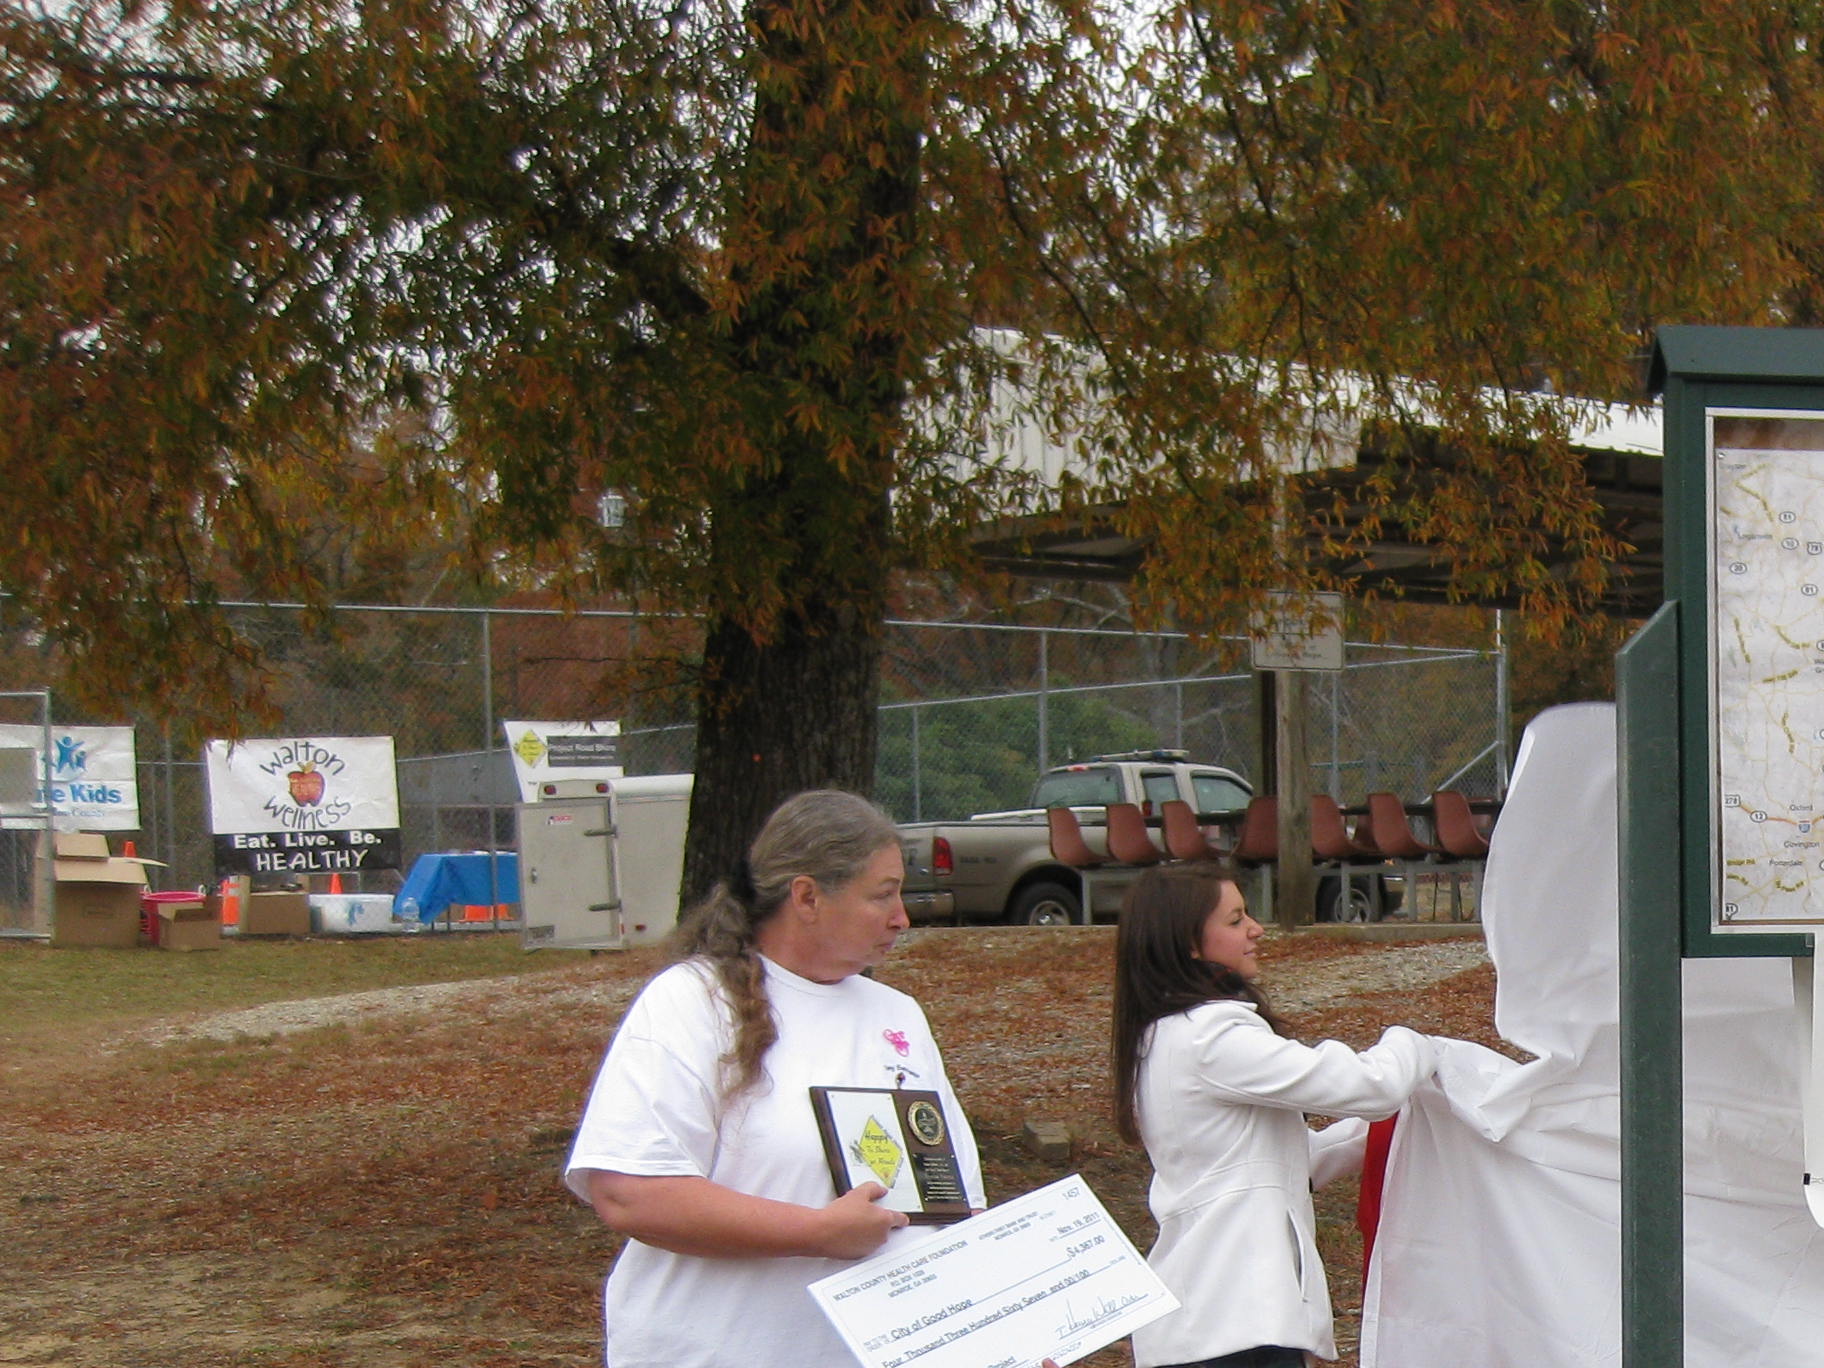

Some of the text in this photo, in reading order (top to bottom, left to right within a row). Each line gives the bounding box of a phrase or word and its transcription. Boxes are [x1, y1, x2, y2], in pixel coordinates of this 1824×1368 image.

[259, 741, 346, 776] walton
[69, 783, 122, 804] Kids
[263, 795, 351, 829] wellness
[234, 831, 382, 849] Eat. Live. Be.
[256, 849, 368, 871] HEALTHY
[890, 1299, 973, 1340] City of Good Hope
[903, 1336, 946, 1361] Thousand
[944, 1326, 970, 1343] Three
[968, 1311, 1002, 1331] Hundred
[1022, 1290, 1048, 1306] Seven
